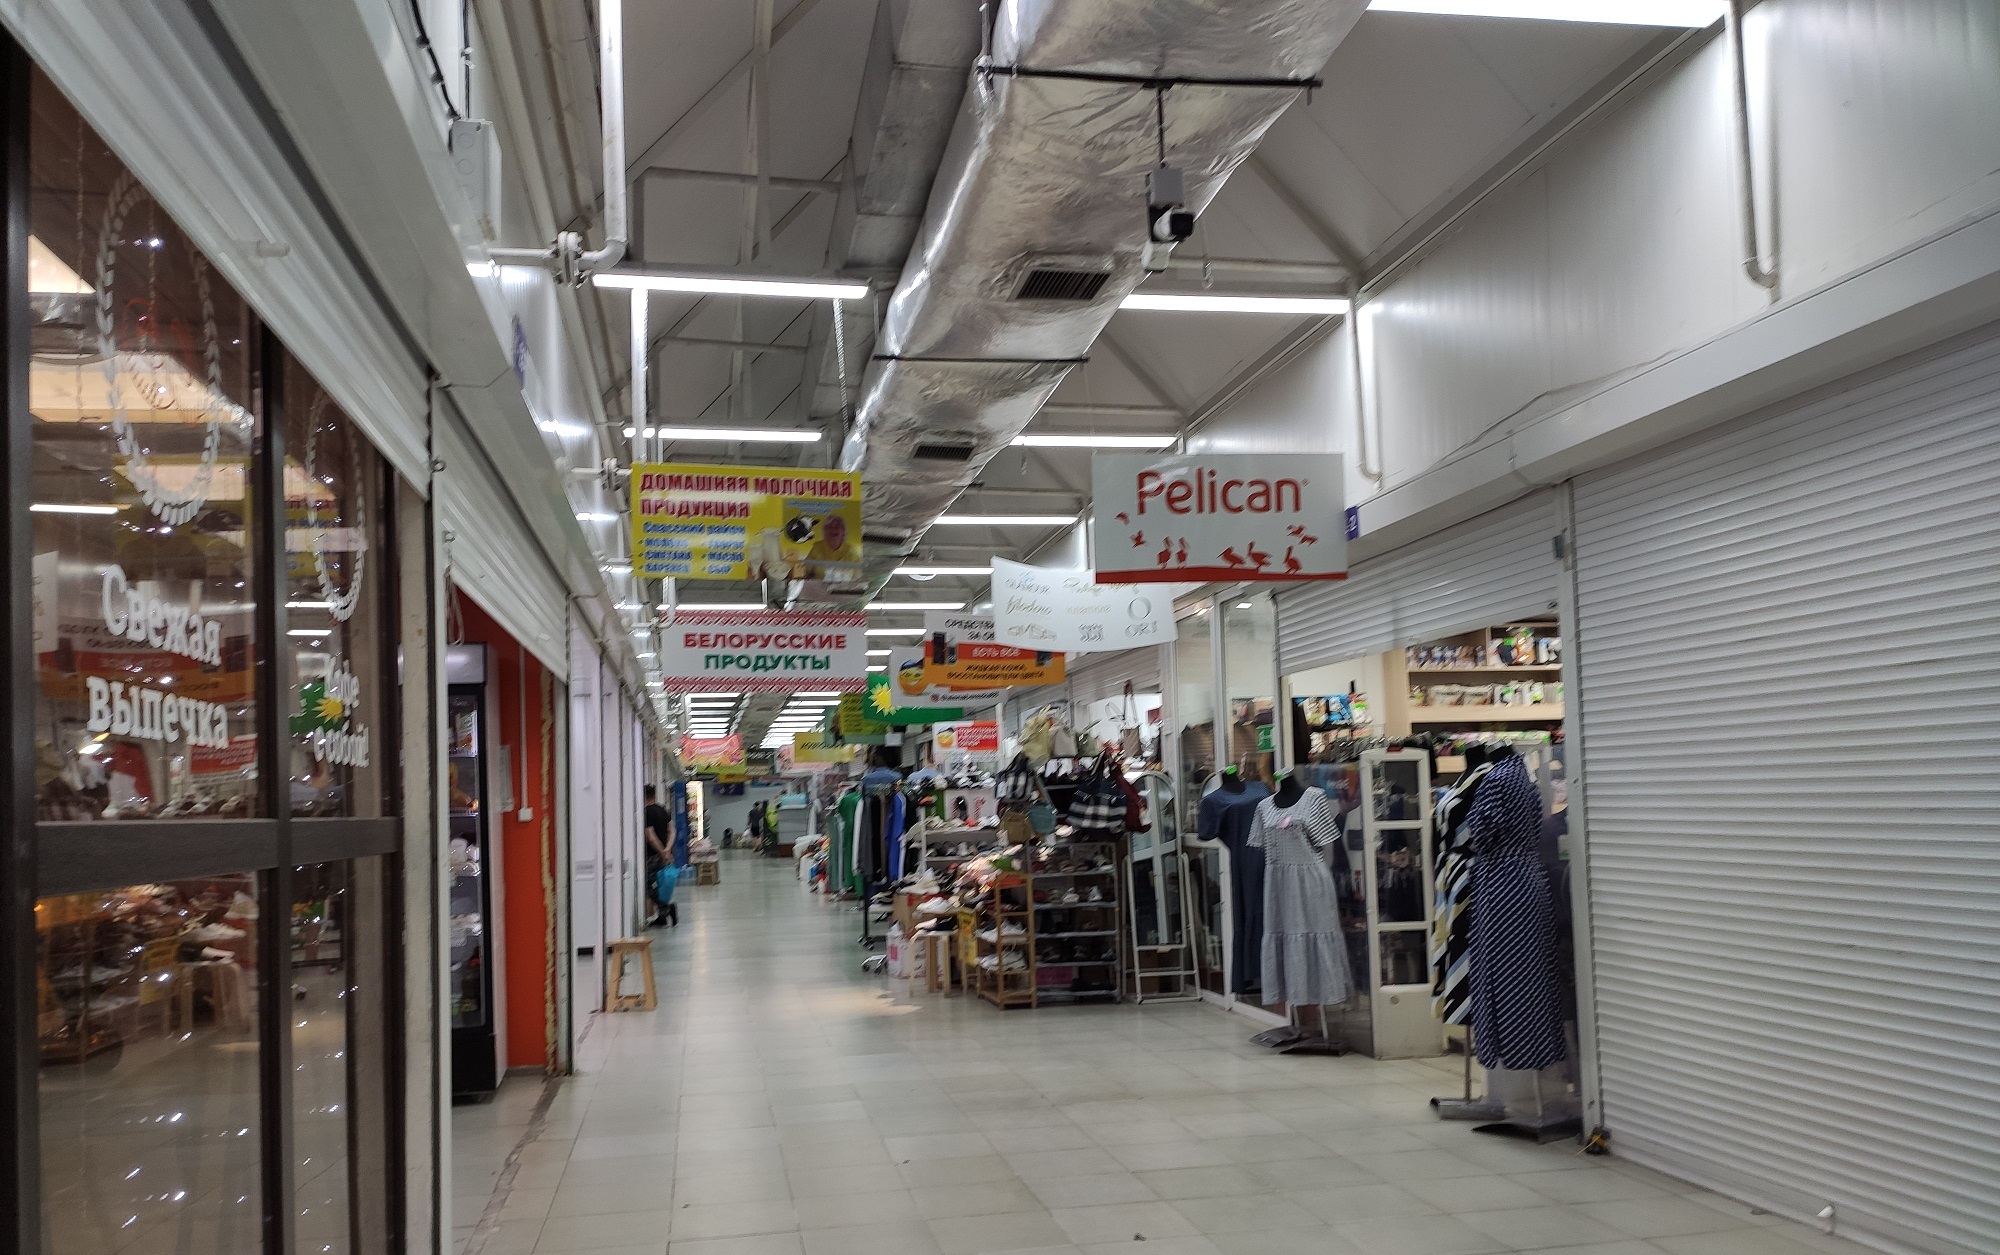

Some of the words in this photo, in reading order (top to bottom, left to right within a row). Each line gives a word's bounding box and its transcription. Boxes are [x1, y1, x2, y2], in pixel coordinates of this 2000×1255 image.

[639, 474, 749, 493] ДОМАШНЯЯ
[753, 477, 853, 498] МОЛОЧНАЯ
[1136, 467, 1302, 516] Pelican
[640, 499, 749, 519] ПРОДУКЦИЯ
[102, 563, 221, 666] Свежая
[683, 632, 848, 649] БЕЛОРУССКИЕ
[704, 654, 831, 672] ПРОДУКТЫ
